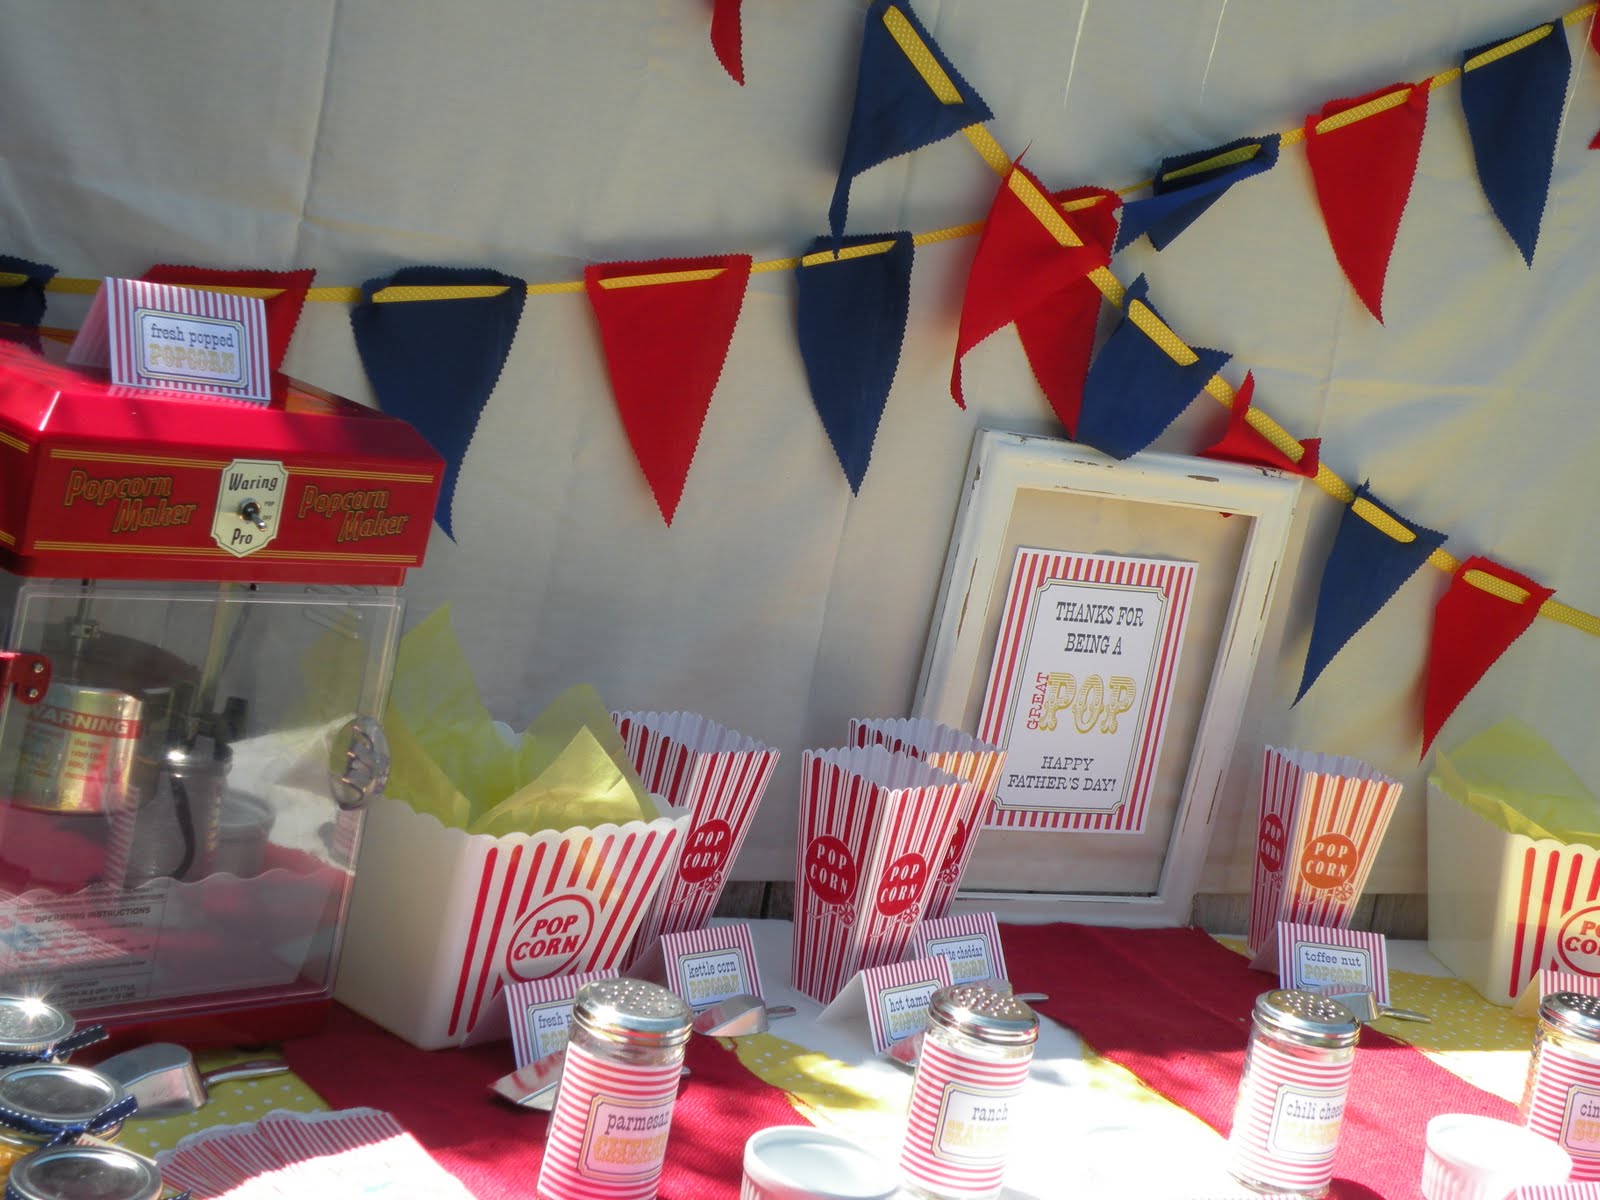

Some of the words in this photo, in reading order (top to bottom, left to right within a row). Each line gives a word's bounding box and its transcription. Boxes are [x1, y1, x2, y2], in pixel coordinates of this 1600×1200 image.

[150, 322, 185, 342] fresh
[188, 331, 235, 350] popped
[149, 343, 235, 375] POPCORN
[63, 468, 173, 506] Popcorn
[228, 473, 279, 491] Waring
[297, 485, 390, 519] Popcorn
[112, 498, 197, 533] Maker
[337, 510, 409, 542] Maker
[231, 527, 253, 545] Pro
[1056, 601, 1115, 626] THANKS
[1116, 606, 1144, 628] FOR
[1064, 633, 1111, 655] BEING
[1112, 636, 1123, 656] A
[1026, 672, 1051, 731] GREAT
[1039, 671, 1137, 735] POP
[1041, 756, 1095, 772] HAPPY
[1007, 774, 1080, 791] FATHER'S
[1082, 778, 1117, 792] DAY!
[693, 830, 725, 848] POP
[1265, 821, 1282, 841] POP
[817, 843, 847, 869] POP
[1260, 839, 1281, 862] CORN
[1314, 841, 1349, 857] POP
[683, 851, 721, 869] CORN
[1305, 859, 1349, 878] CORN
[810, 864, 848, 895] CORN
[890, 863, 920, 881] POP
[880, 884, 917, 904] CORN
[35, 912, 86, 924] OPERATING
[88, 906, 151, 920] INSTRUCTIONS
[531, 914, 579, 938] POP
[513, 934, 580, 961] CORN
[957, 944, 983, 959] cheddar
[1565, 936, 1600, 956] CO
[1305, 950, 1338, 964] toffee
[1341, 956, 1361, 967] nut
[687, 961, 715, 978] kettle
[717, 961, 737, 973] corn
[951, 959, 987, 980] PCORN
[1304, 963, 1363, 984] POPCORN
[689, 974, 740, 999] POPCORN
[888, 998, 905, 1012] hot
[905, 990, 930, 1009] tamal
[538, 1012, 564, 1029] fresh
[971, 1103, 1008, 1121] ranch
[1286, 1099, 1315, 1120] chili
[1319, 1102, 1343, 1120] chees
